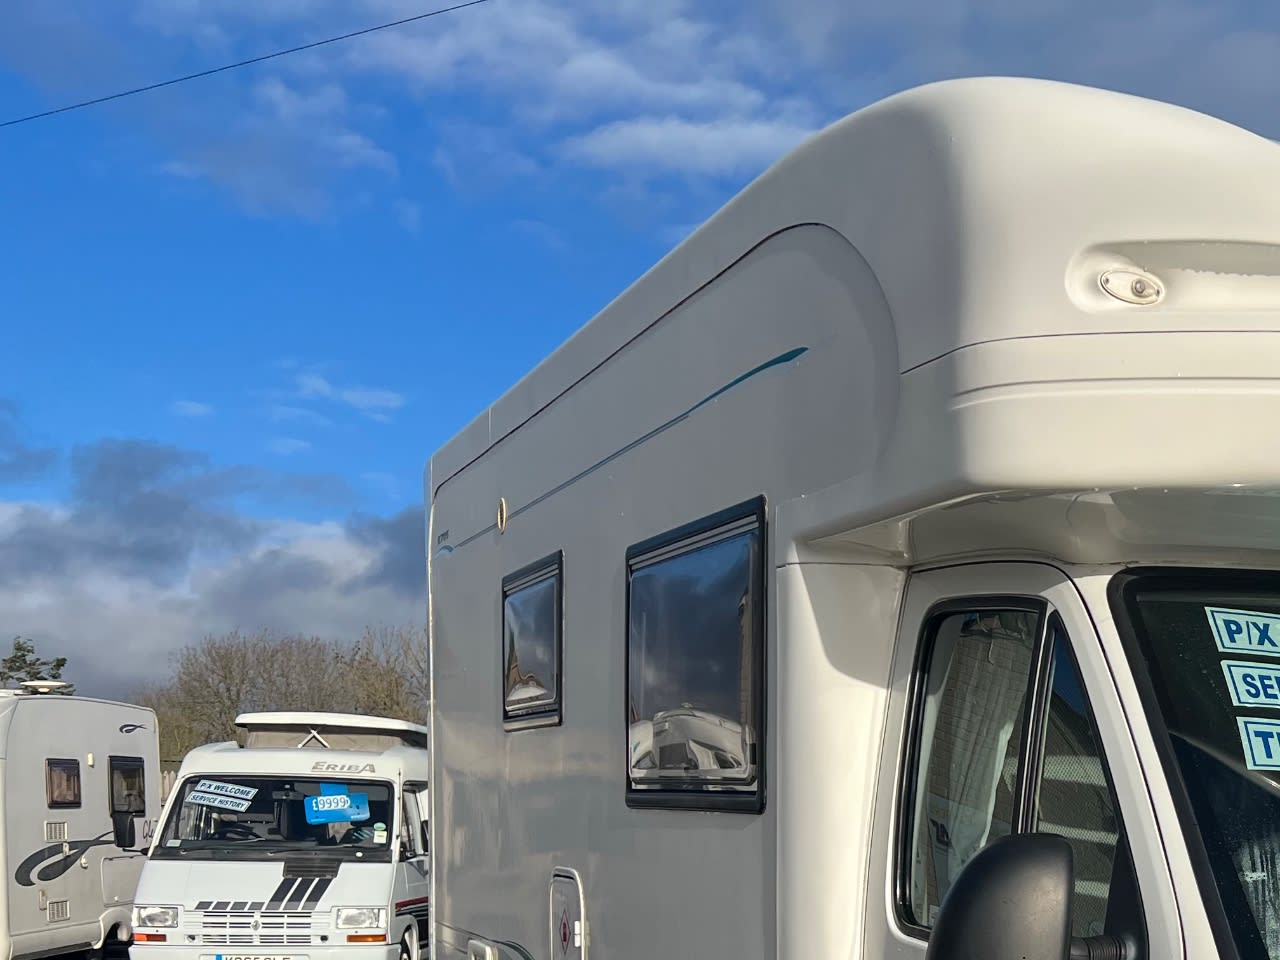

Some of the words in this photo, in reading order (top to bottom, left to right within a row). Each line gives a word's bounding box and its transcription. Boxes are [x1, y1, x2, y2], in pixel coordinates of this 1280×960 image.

[1223, 618, 1279, 648] P/X
[213, 784, 252, 797] WELCOME
[190, 794, 218, 804] SERVICE
[218, 798, 246, 809] HISTORY
